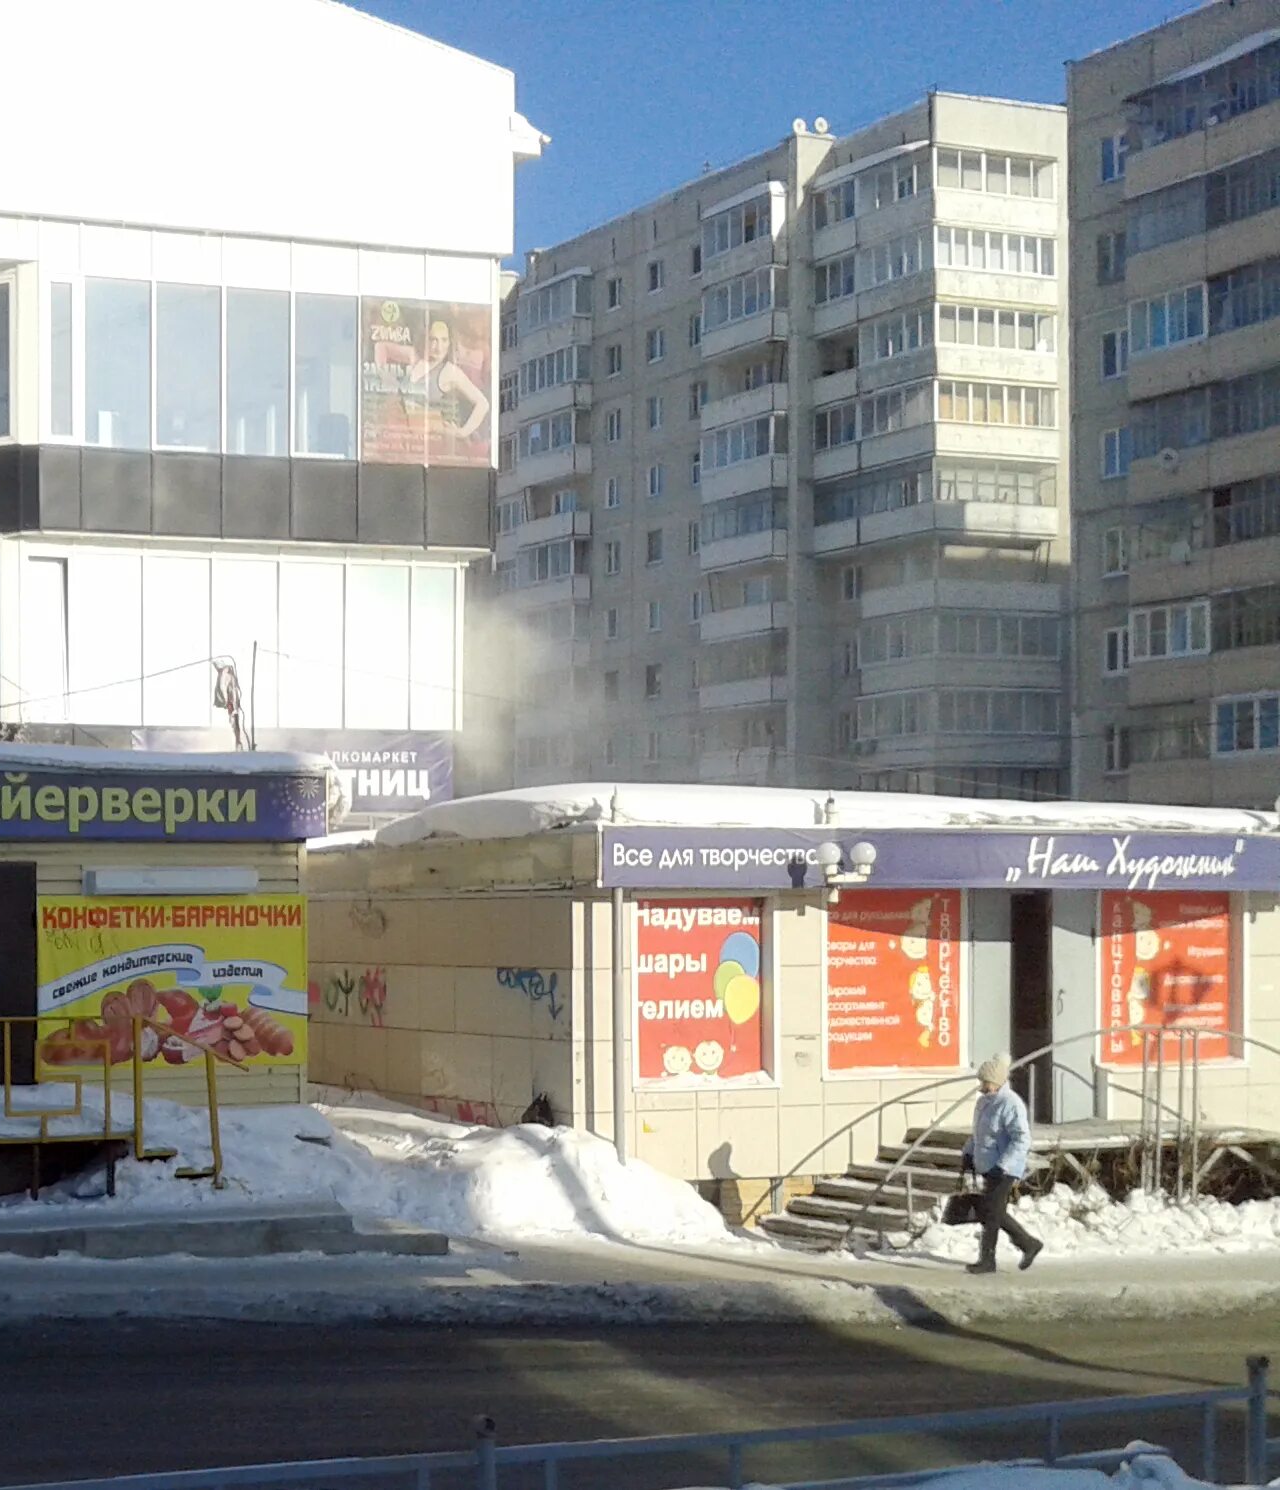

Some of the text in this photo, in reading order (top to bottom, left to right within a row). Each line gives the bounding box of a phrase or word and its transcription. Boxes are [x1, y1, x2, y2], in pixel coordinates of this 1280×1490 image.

[613, 843, 653, 866] Все
[658, 847, 694, 869] для
[52, 950, 264, 1000] свежие кондитерские изделия
[637, 952, 707, 979] шары
